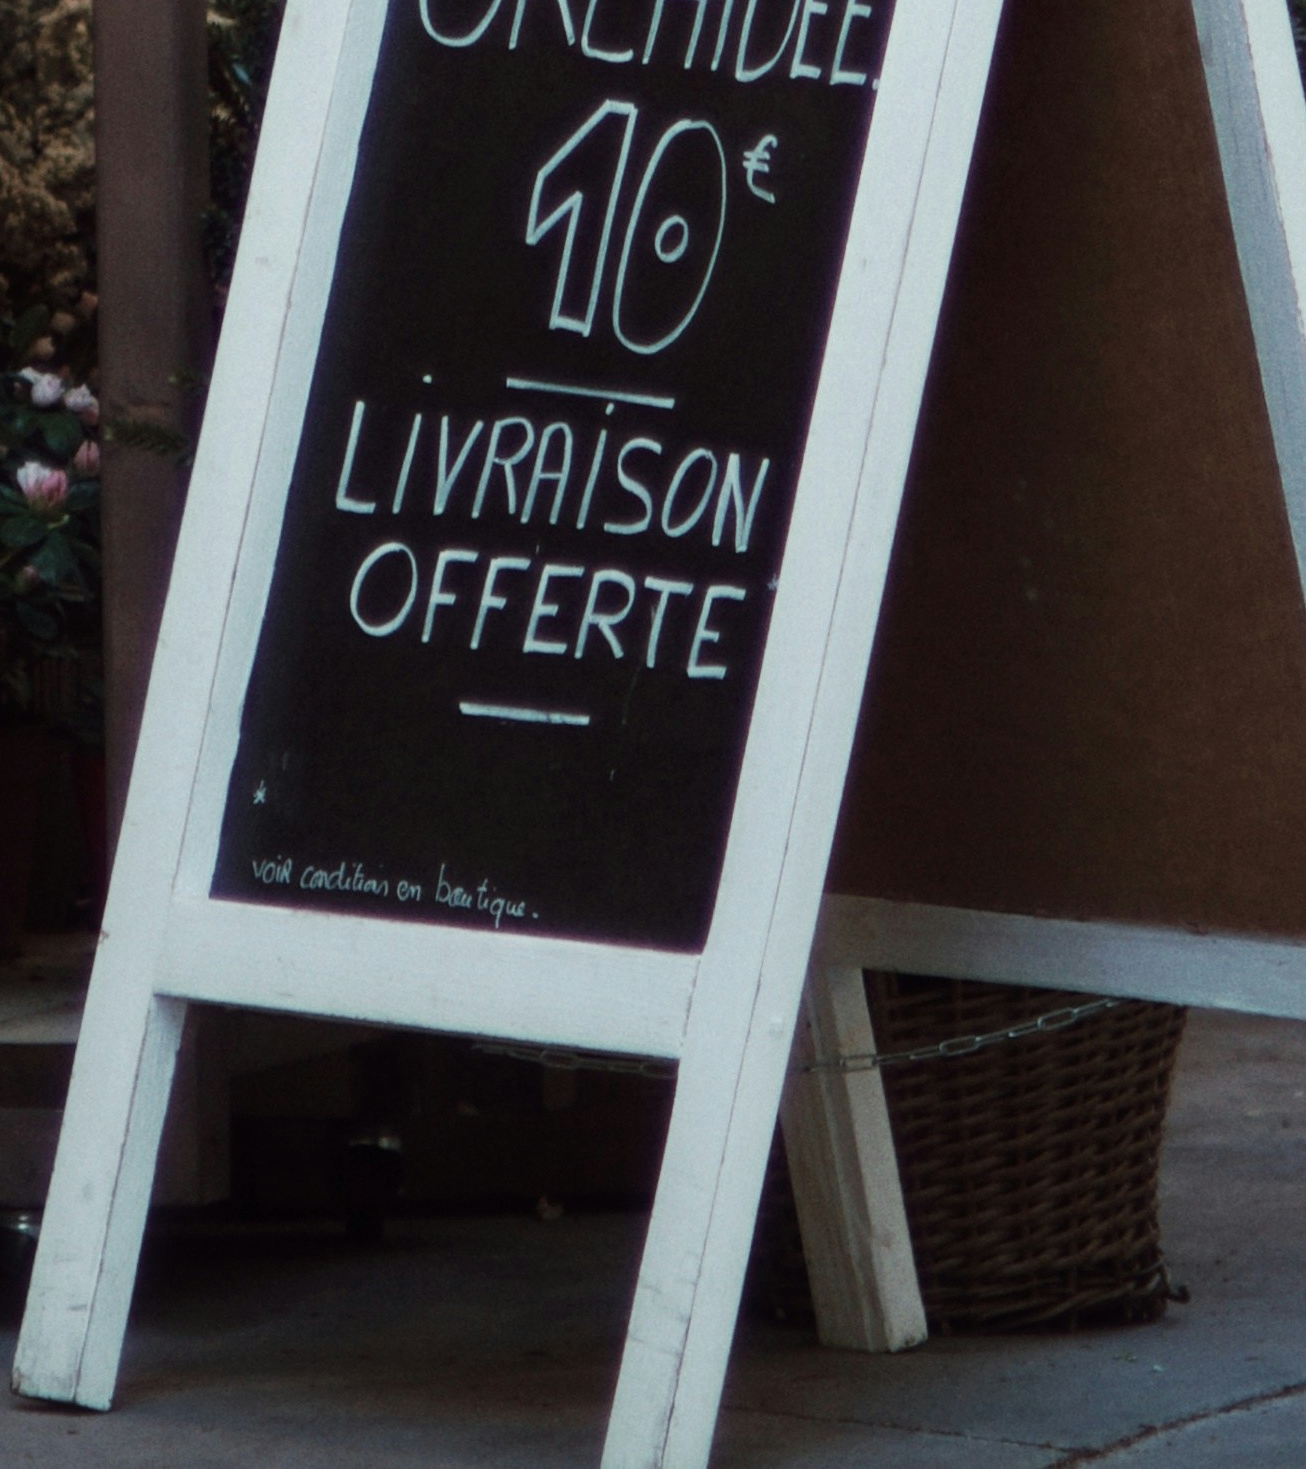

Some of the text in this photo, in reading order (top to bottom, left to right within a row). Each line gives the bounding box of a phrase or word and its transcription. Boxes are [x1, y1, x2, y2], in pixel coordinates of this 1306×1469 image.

[335, 375, 770, 554] LIVRAISON
[349, 541, 747, 680] OFFERTE
[396, 880, 422, 901] en
